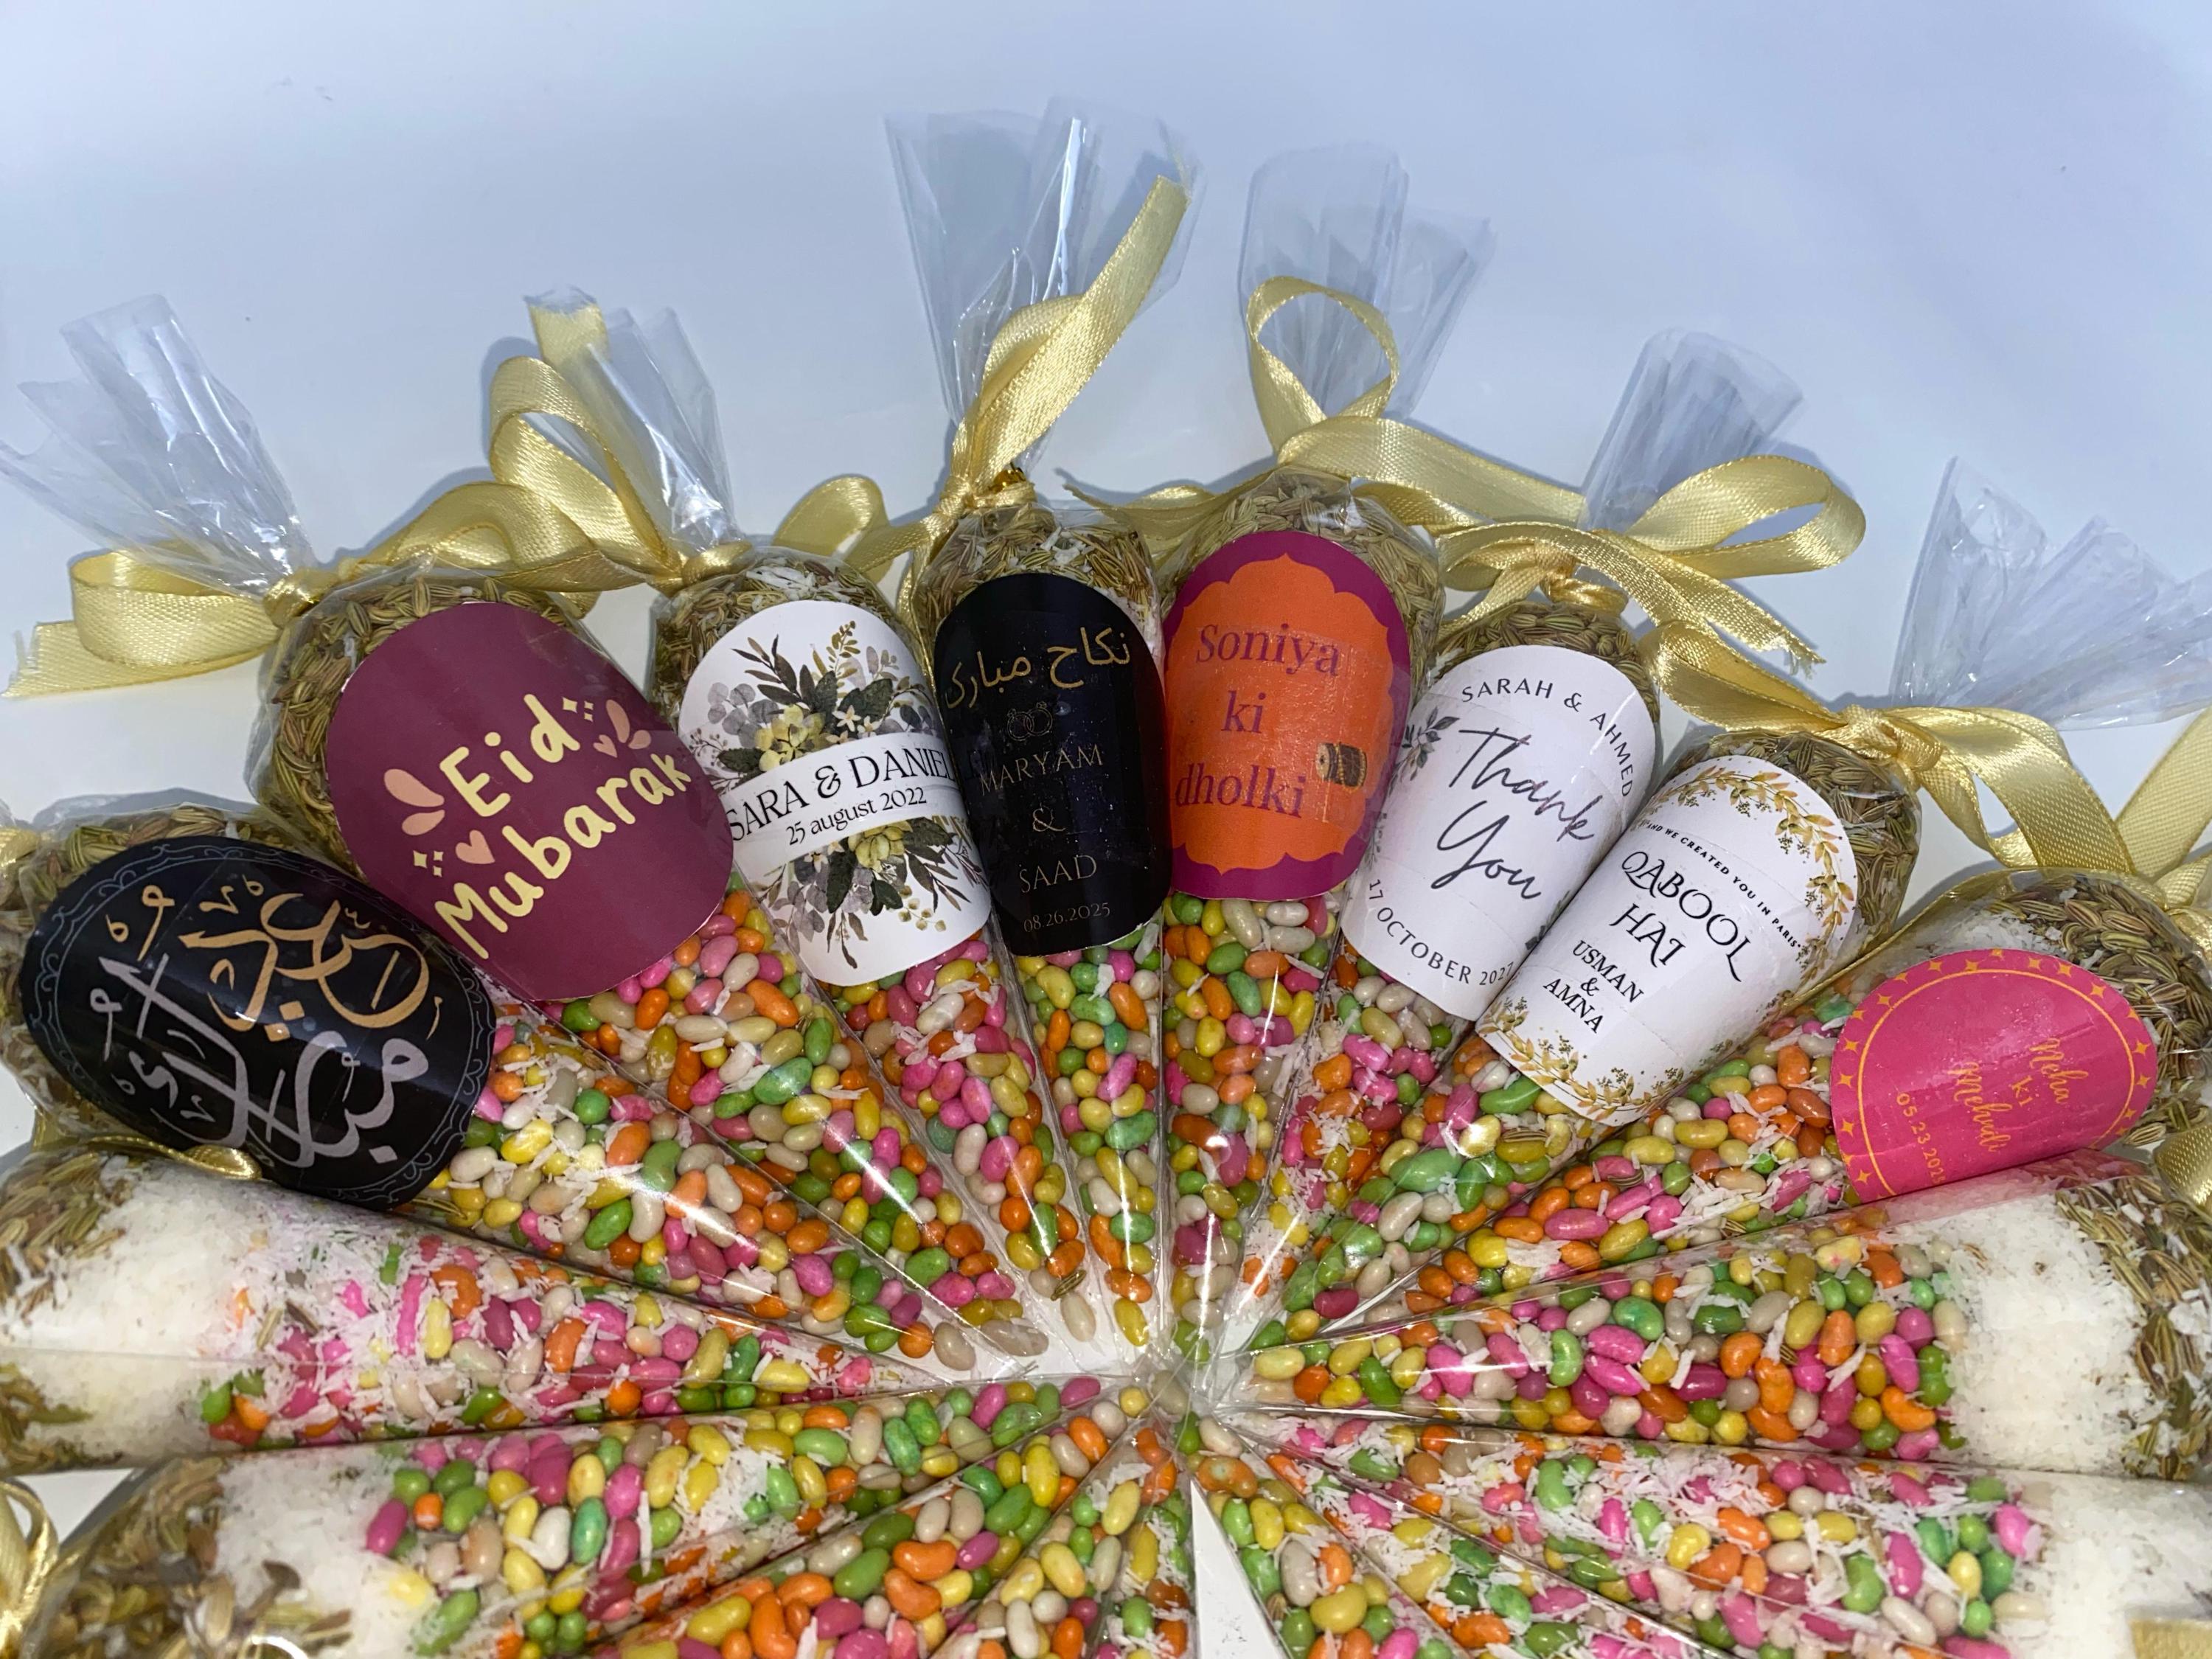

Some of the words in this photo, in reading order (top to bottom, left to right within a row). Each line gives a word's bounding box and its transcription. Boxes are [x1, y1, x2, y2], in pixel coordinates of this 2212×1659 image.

[1196, 623, 1339, 676] Soniya
[1220, 690, 1267, 734] ki
[1461, 678, 1554, 702] SARAH
[1563, 692, 1584, 712] &
[1590, 712, 1633, 797] AHMED
[439, 694, 581, 817] Eid
[979, 743, 1103, 796] MARYAM
[1448, 727, 1604, 842] Thank
[726, 780, 810, 841] SARA
[814, 765, 841, 799] &
[848, 747, 956, 788] DANIEL
[785, 821, 805, 846] 25
[810, 799, 877, 831] august
[880, 787, 928, 811] 2022
[1032, 804, 1066, 832] &
[1175, 761, 1306, 818] dholki
[434, 754, 692, 959] Mubarak
[1019, 855, 1097, 894] SAAD
[1430, 800, 1542, 900] You
[1664, 828, 1680, 839] WE
[1680, 837, 1730, 874] CREATED
[1733, 876, 1756, 900] YOU
[1757, 901, 1771, 916] IN
[1023, 902, 1111, 933] 08.26.2025
[1368, 879, 1384, 900] 17
[1377, 907, 1472, 984] OCTOBER
[1609, 902, 1687, 969] HAI
[1621, 850, 1751, 982] QABOOL
[1572, 939, 1644, 1004] USMAN
[1580, 977, 1600, 997] &
[1543, 978, 1604, 1034] AMNA
[2010, 1075, 2034, 1107] ki
[2028, 1037, 2089, 1105] Neha
[1947, 1060, 2014, 1152] Mehndi
